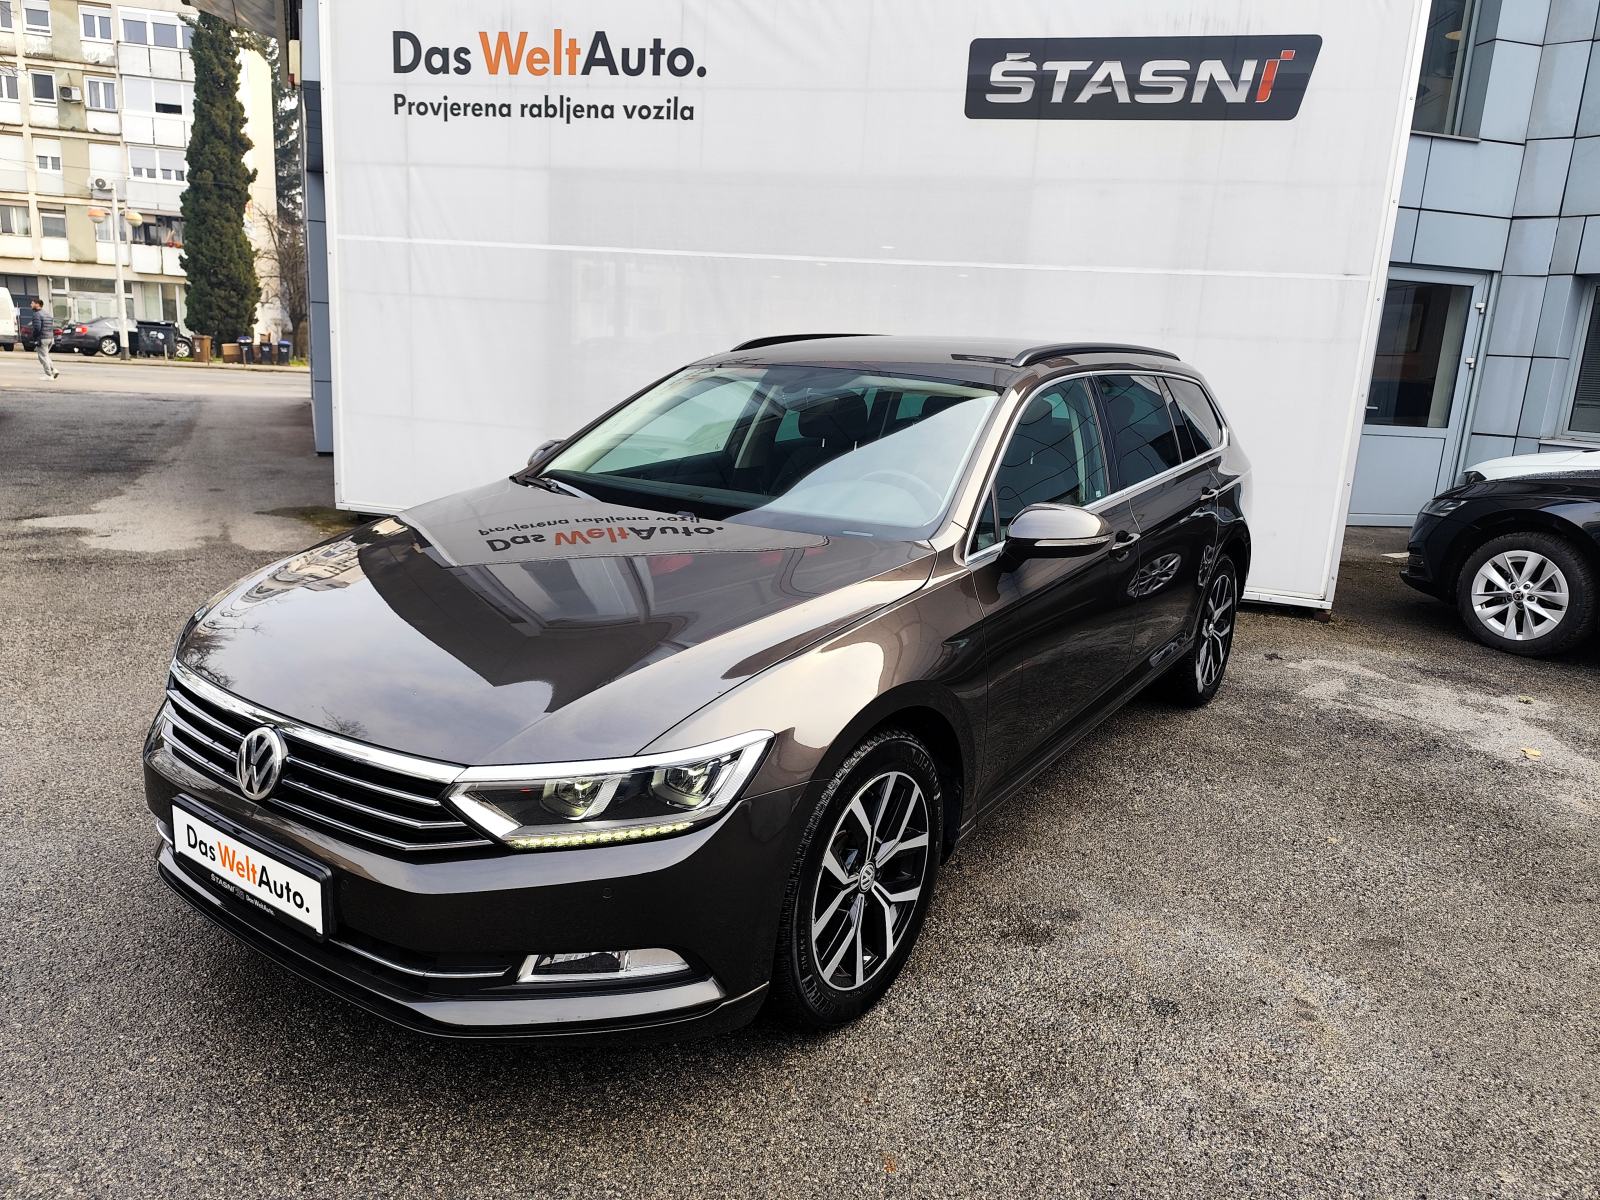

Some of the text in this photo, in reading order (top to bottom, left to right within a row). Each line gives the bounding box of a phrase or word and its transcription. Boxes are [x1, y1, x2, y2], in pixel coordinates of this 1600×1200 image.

[393, 28, 707, 77] Das WeltAuto.
[393, 93, 695, 124] Provjerena rabljena vozila
[186, 823, 310, 914] Das WeltAuto.
